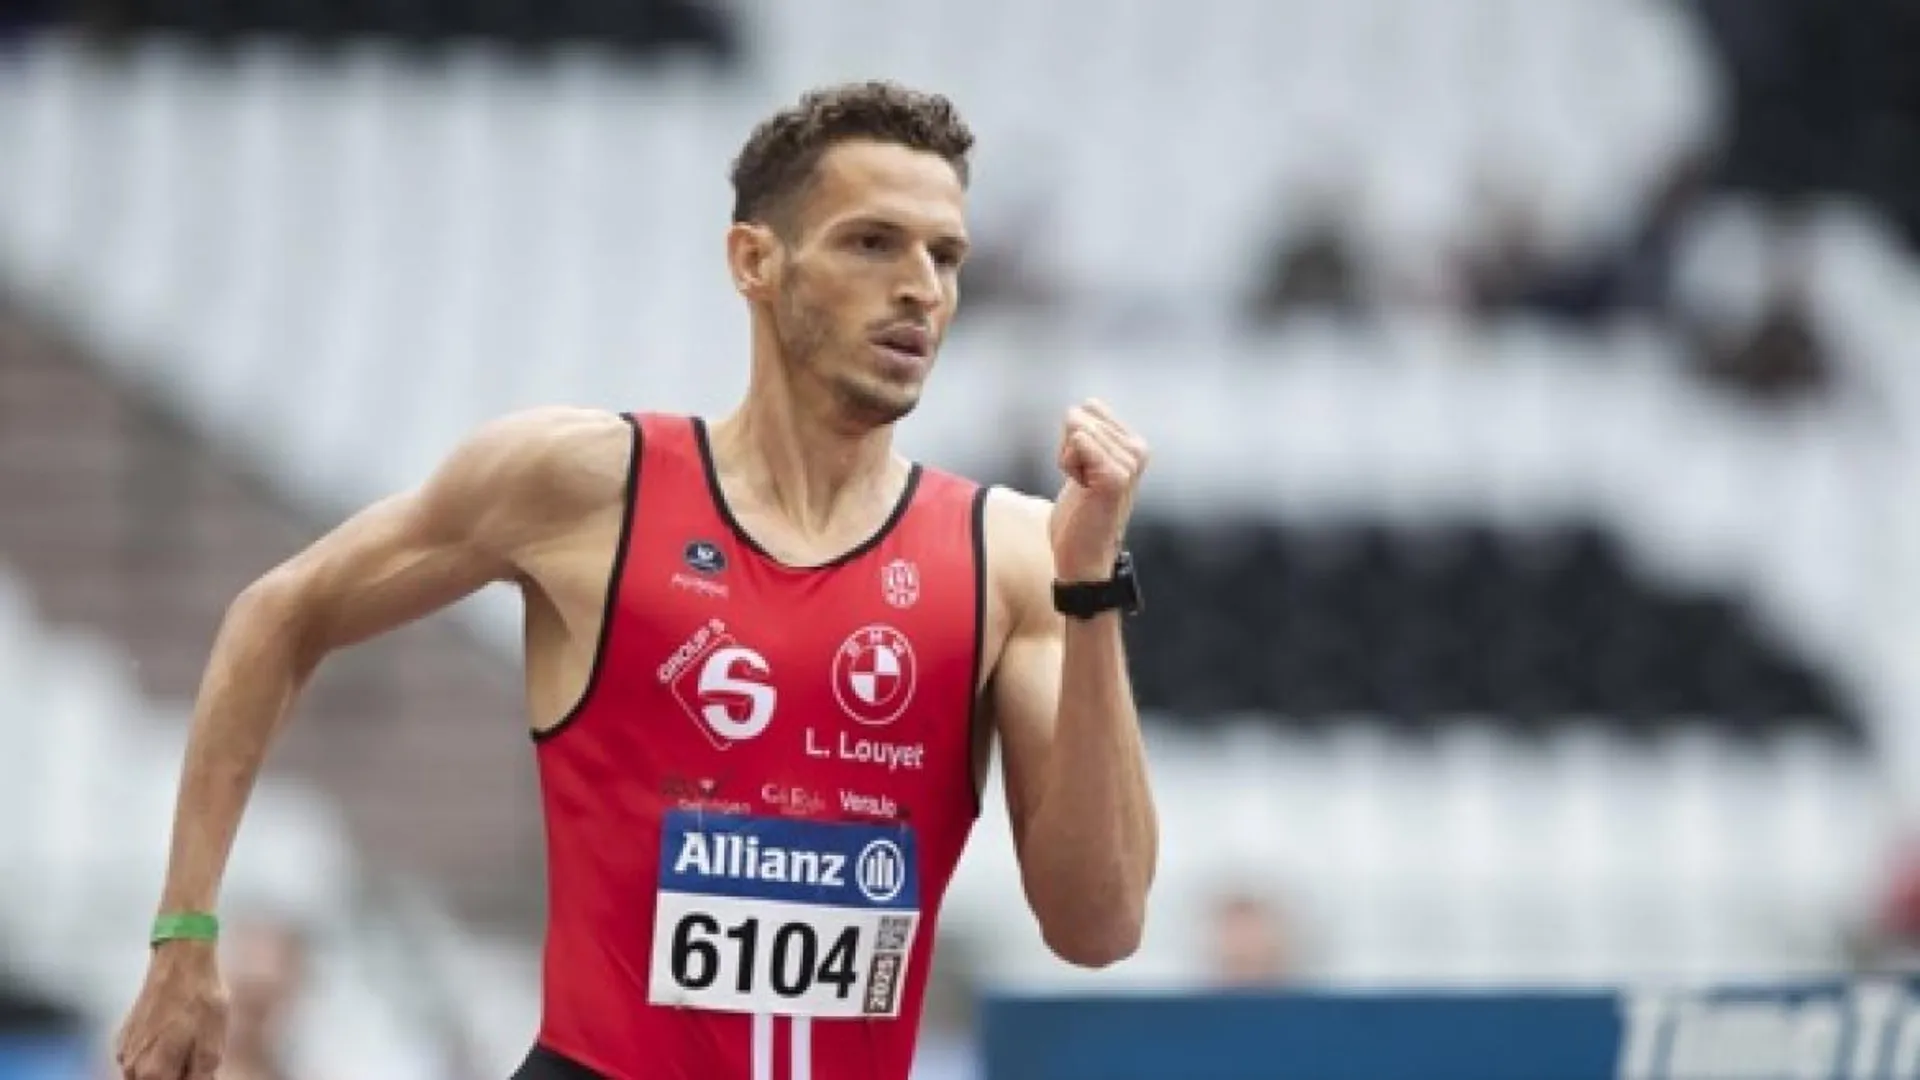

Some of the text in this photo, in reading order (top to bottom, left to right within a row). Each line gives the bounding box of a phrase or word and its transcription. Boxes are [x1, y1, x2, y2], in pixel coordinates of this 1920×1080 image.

[697, 646, 778, 740] S
[805, 727, 924, 770] L. Louyet
[674, 832, 847, 887] Allianz
[670, 911, 861, 1000] 6104
